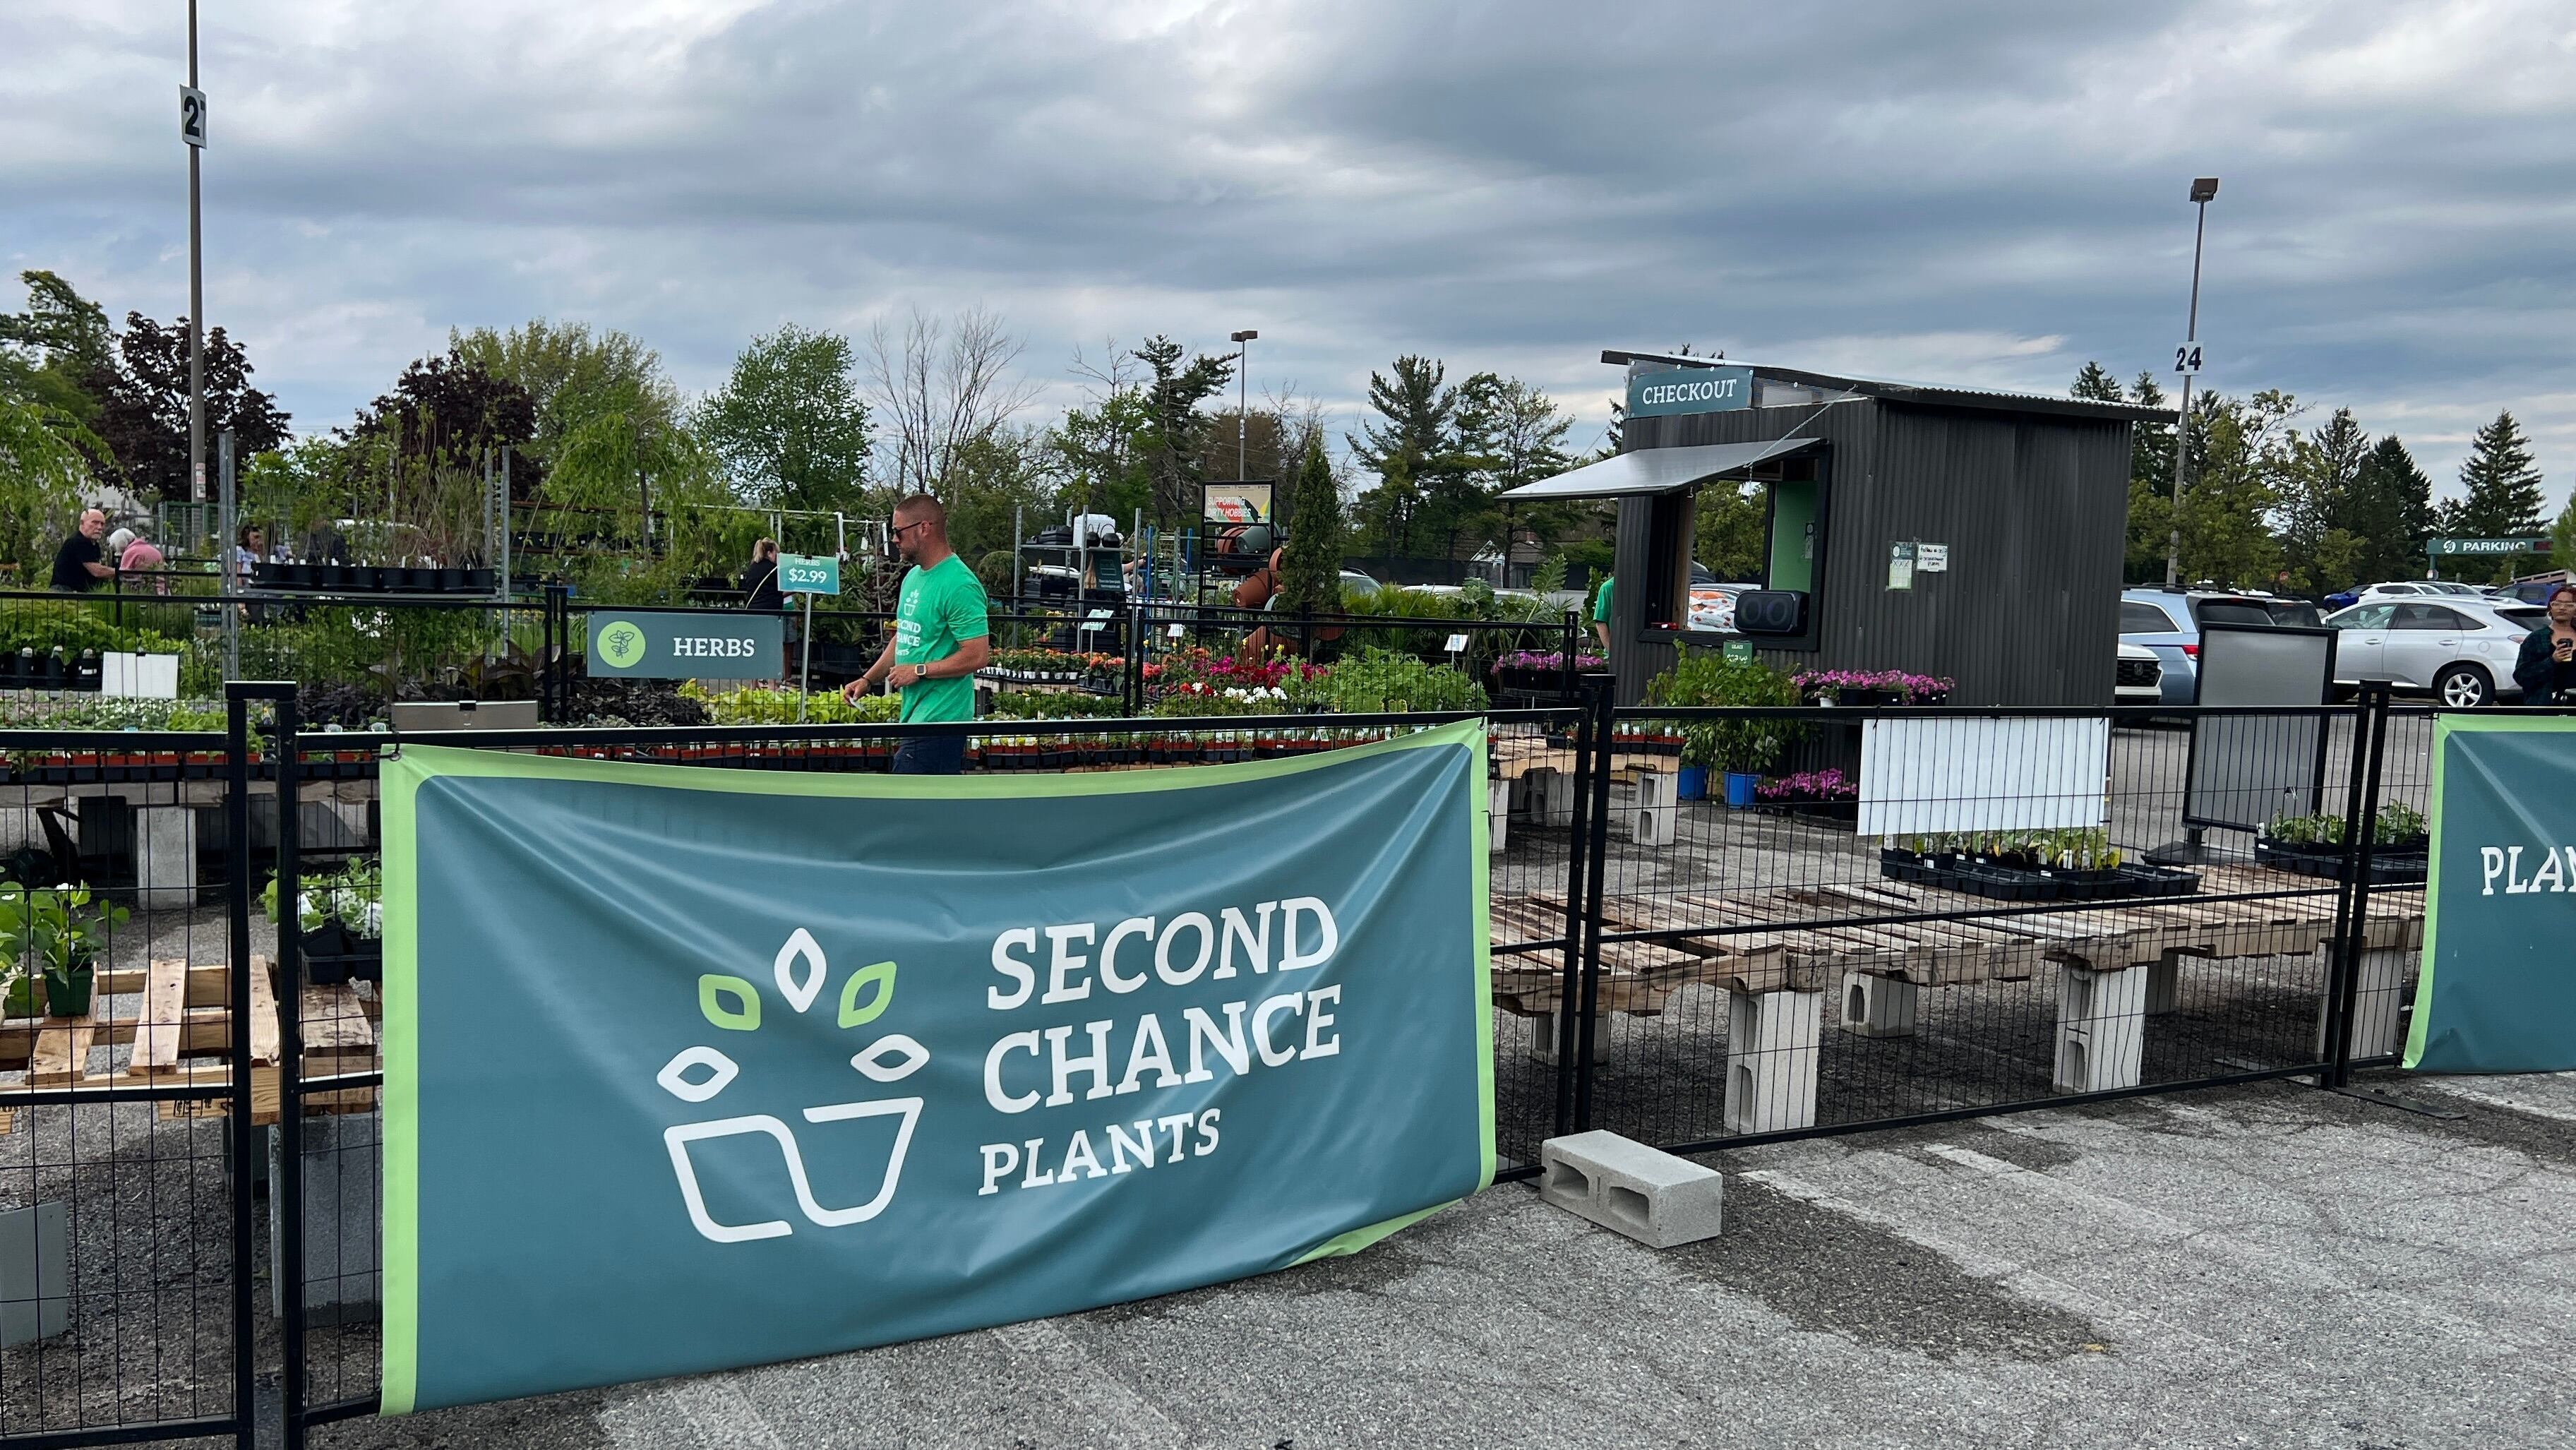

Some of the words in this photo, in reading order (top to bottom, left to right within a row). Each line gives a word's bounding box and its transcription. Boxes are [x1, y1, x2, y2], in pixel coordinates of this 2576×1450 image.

[2175, 347, 2201, 371] 24
[1643, 378, 1737, 405] CHECKOUT
[1208, 496, 1245, 505] SUPPORTING
[1207, 508, 1224, 517] DIRTY
[1225, 508, 1252, 517] HOBBIES
[795, 558, 820, 566] HERBS
[789, 567, 827, 584] $2.99
[673, 637, 755, 657] HERBS
[988, 897, 1338, 1010] SECOND
[983, 984, 1341, 1114] CHANCE
[978, 1108, 1221, 1196] PLANTS
